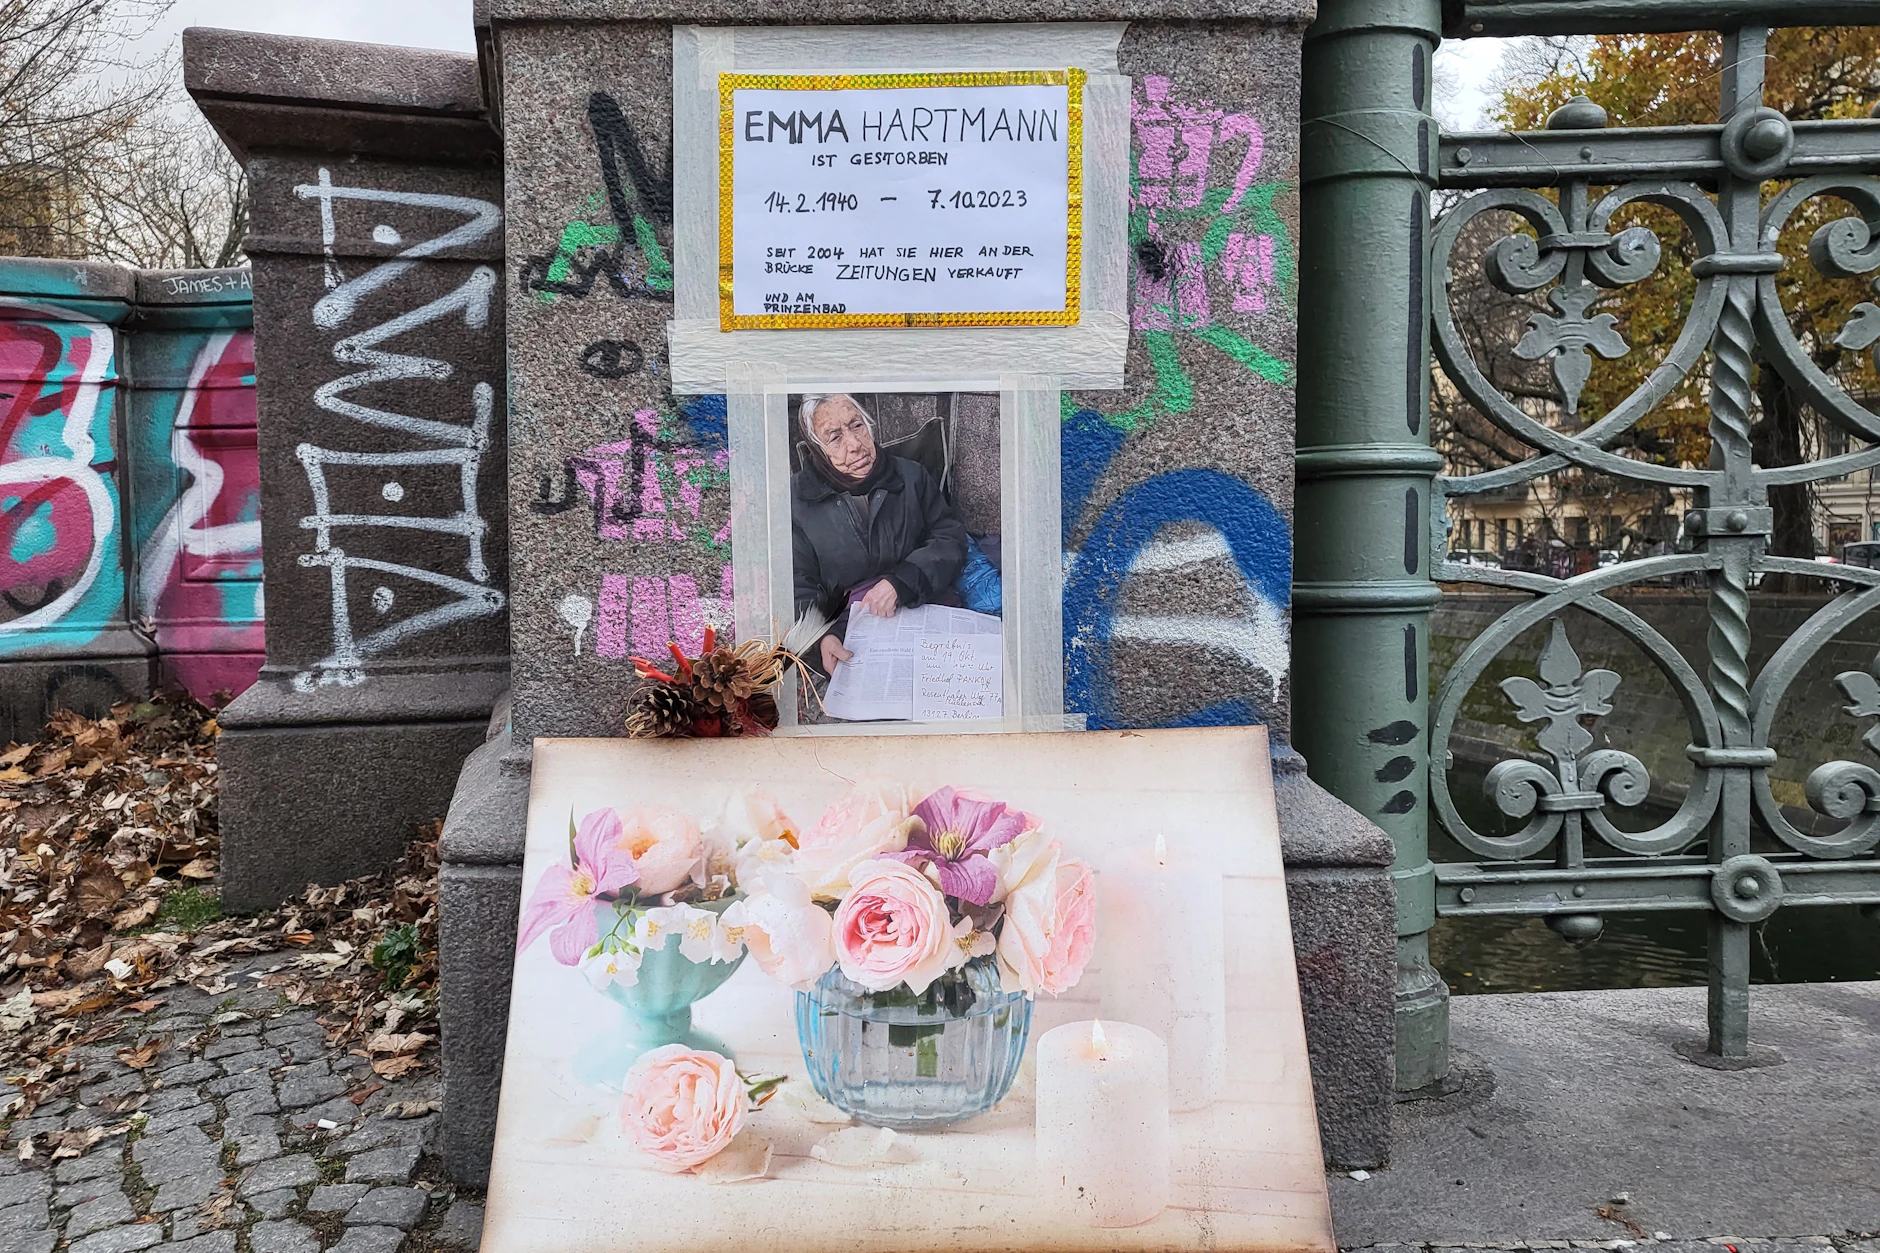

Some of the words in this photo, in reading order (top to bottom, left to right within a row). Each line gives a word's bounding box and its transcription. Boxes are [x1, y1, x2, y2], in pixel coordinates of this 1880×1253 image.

[744, 109, 849, 144] EMMA
[862, 107, 1058, 143] HARTMANN
[811, 153, 838, 168] IST
[850, 151, 949, 166] GESTORBEN
[764, 190, 859, 213] 14.2.1940
[766, 247, 797, 258] SEIT
[807, 246, 845, 260] 2004
[859, 247, 885, 258] HAT
[896, 247, 917, 258] SIE
[929, 247, 964, 258] HIER
[978, 245, 998, 257] AN
[1001, 245, 1034, 257] DER
[764, 261, 814, 274] BRÜCKE
[836, 264, 937, 283] ZEITUNGEN
[947, 266, 1023, 280] VERKAUFT
[162, 275, 224, 296] JAMES
[765, 292, 789, 303] UND
[795, 292, 815, 304] AM
[763, 303, 847, 314] PRINZENBAD
[921, 673, 954, 687] Friedhof
[957, 674, 992, 684] PANKOW
[921, 709, 948, 719] 13127
[951, 709, 980, 719] Berlin
